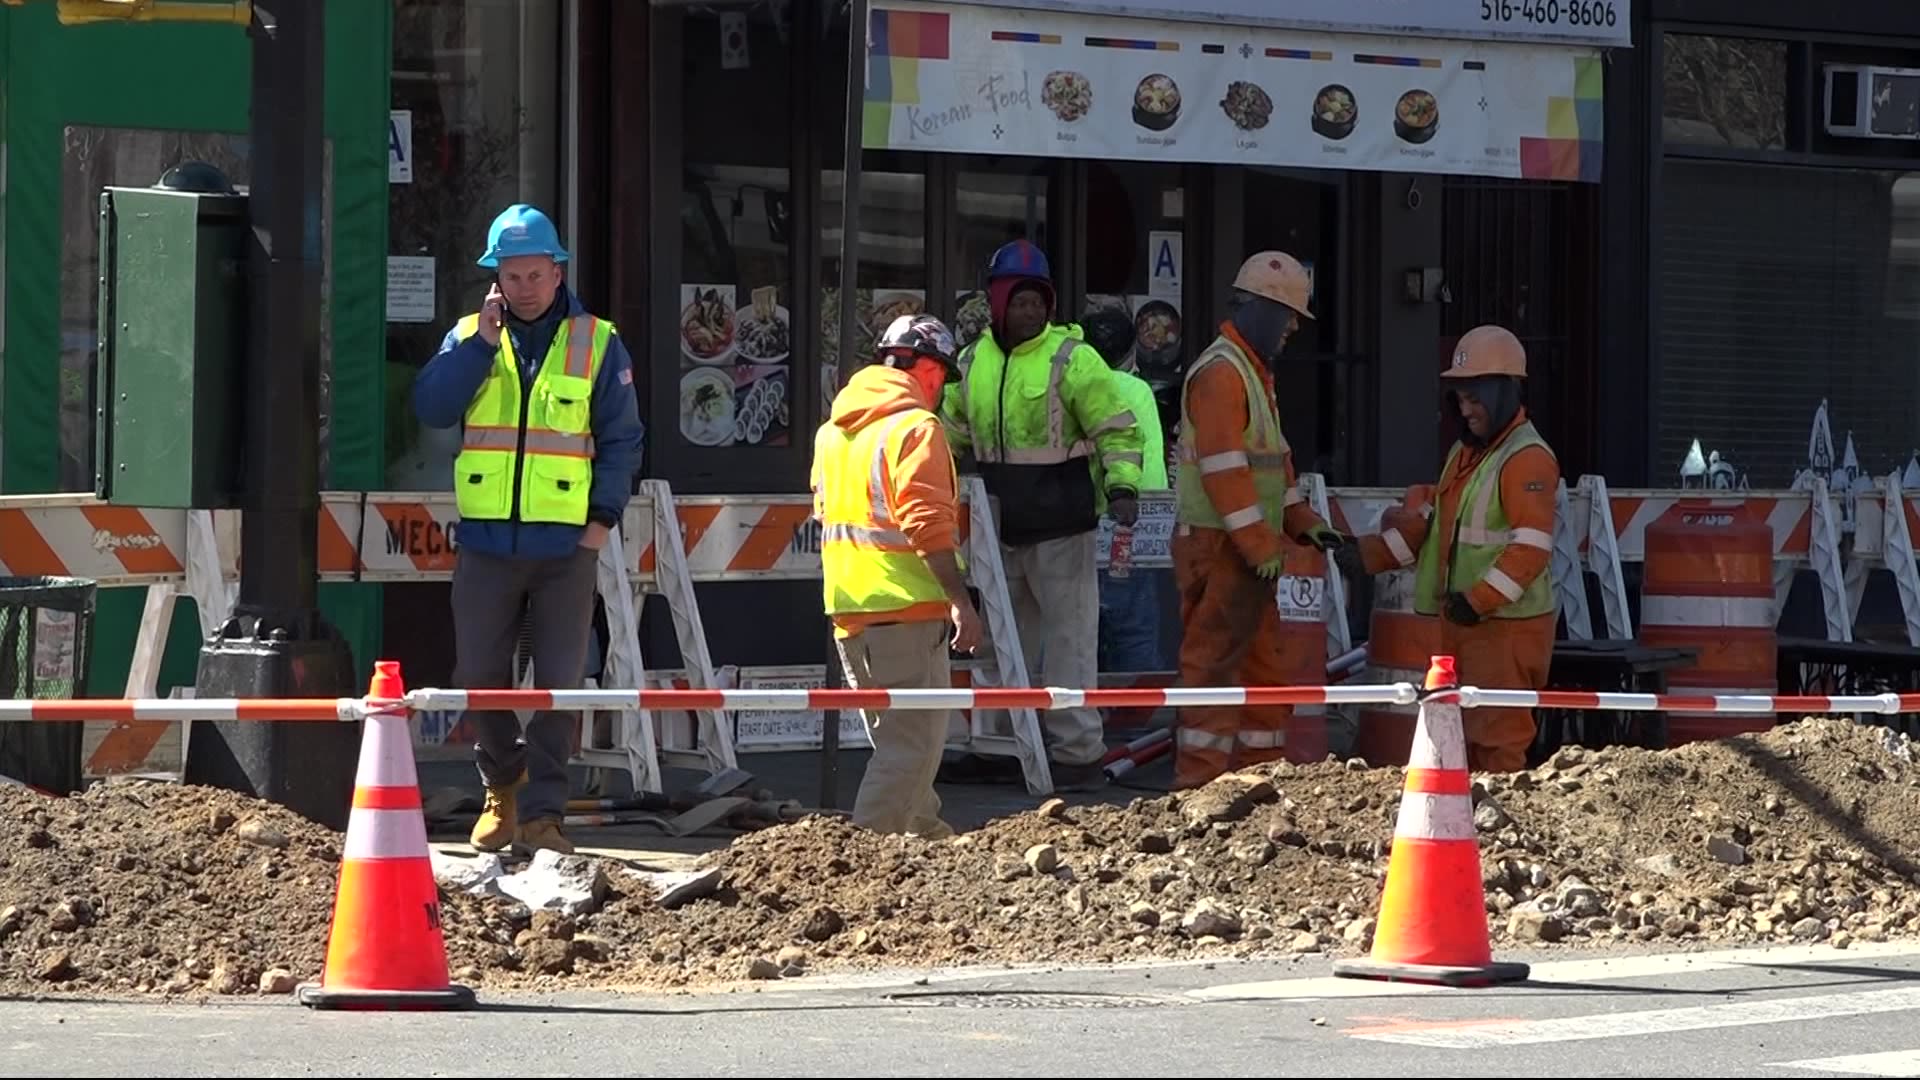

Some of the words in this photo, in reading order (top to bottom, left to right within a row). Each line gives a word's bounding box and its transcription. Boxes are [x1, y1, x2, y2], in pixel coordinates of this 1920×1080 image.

[1481, 0, 1616, 27] 516-460-8606
[907, 104, 972, 140] Korean
[978, 70, 1032, 116] Food
[1154, 240, 1176, 277] A
